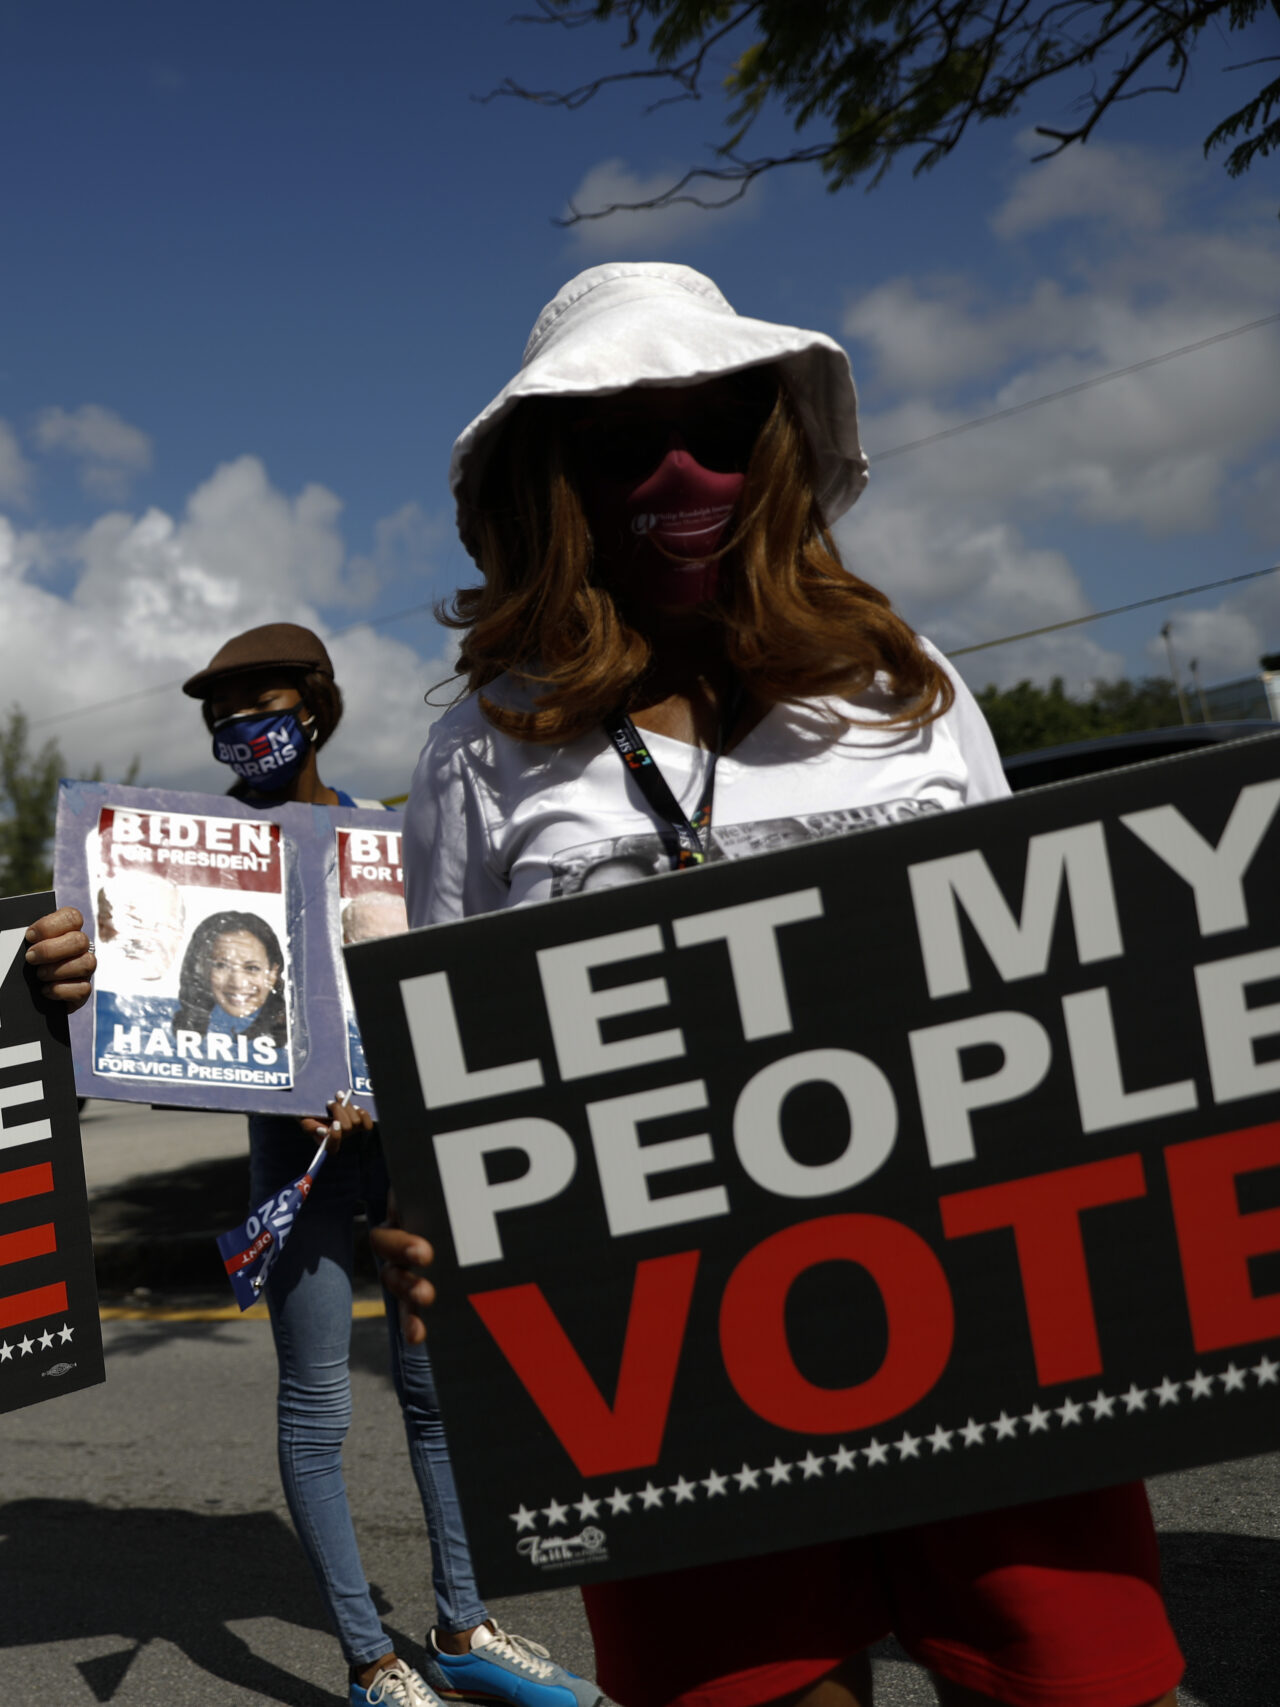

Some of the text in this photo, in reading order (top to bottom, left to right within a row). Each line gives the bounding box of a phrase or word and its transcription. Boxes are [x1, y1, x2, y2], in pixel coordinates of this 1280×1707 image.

[217, 726, 289, 762] BIDEN
[232, 744, 297, 777] ARRIS
[112, 810, 271, 855] BIDEN
[157, 849, 271, 872] PRESIDENT
[351, 865, 393, 882] FOR
[398, 778, 1280, 1111] LET MY
[114, 1024, 278, 1066] HARRIS
[98, 1057, 290, 1085] FOR VICE PRESIDENT
[432, 947, 1280, 1268] PEOPLE
[467, 1120, 1280, 1478] VOTE
